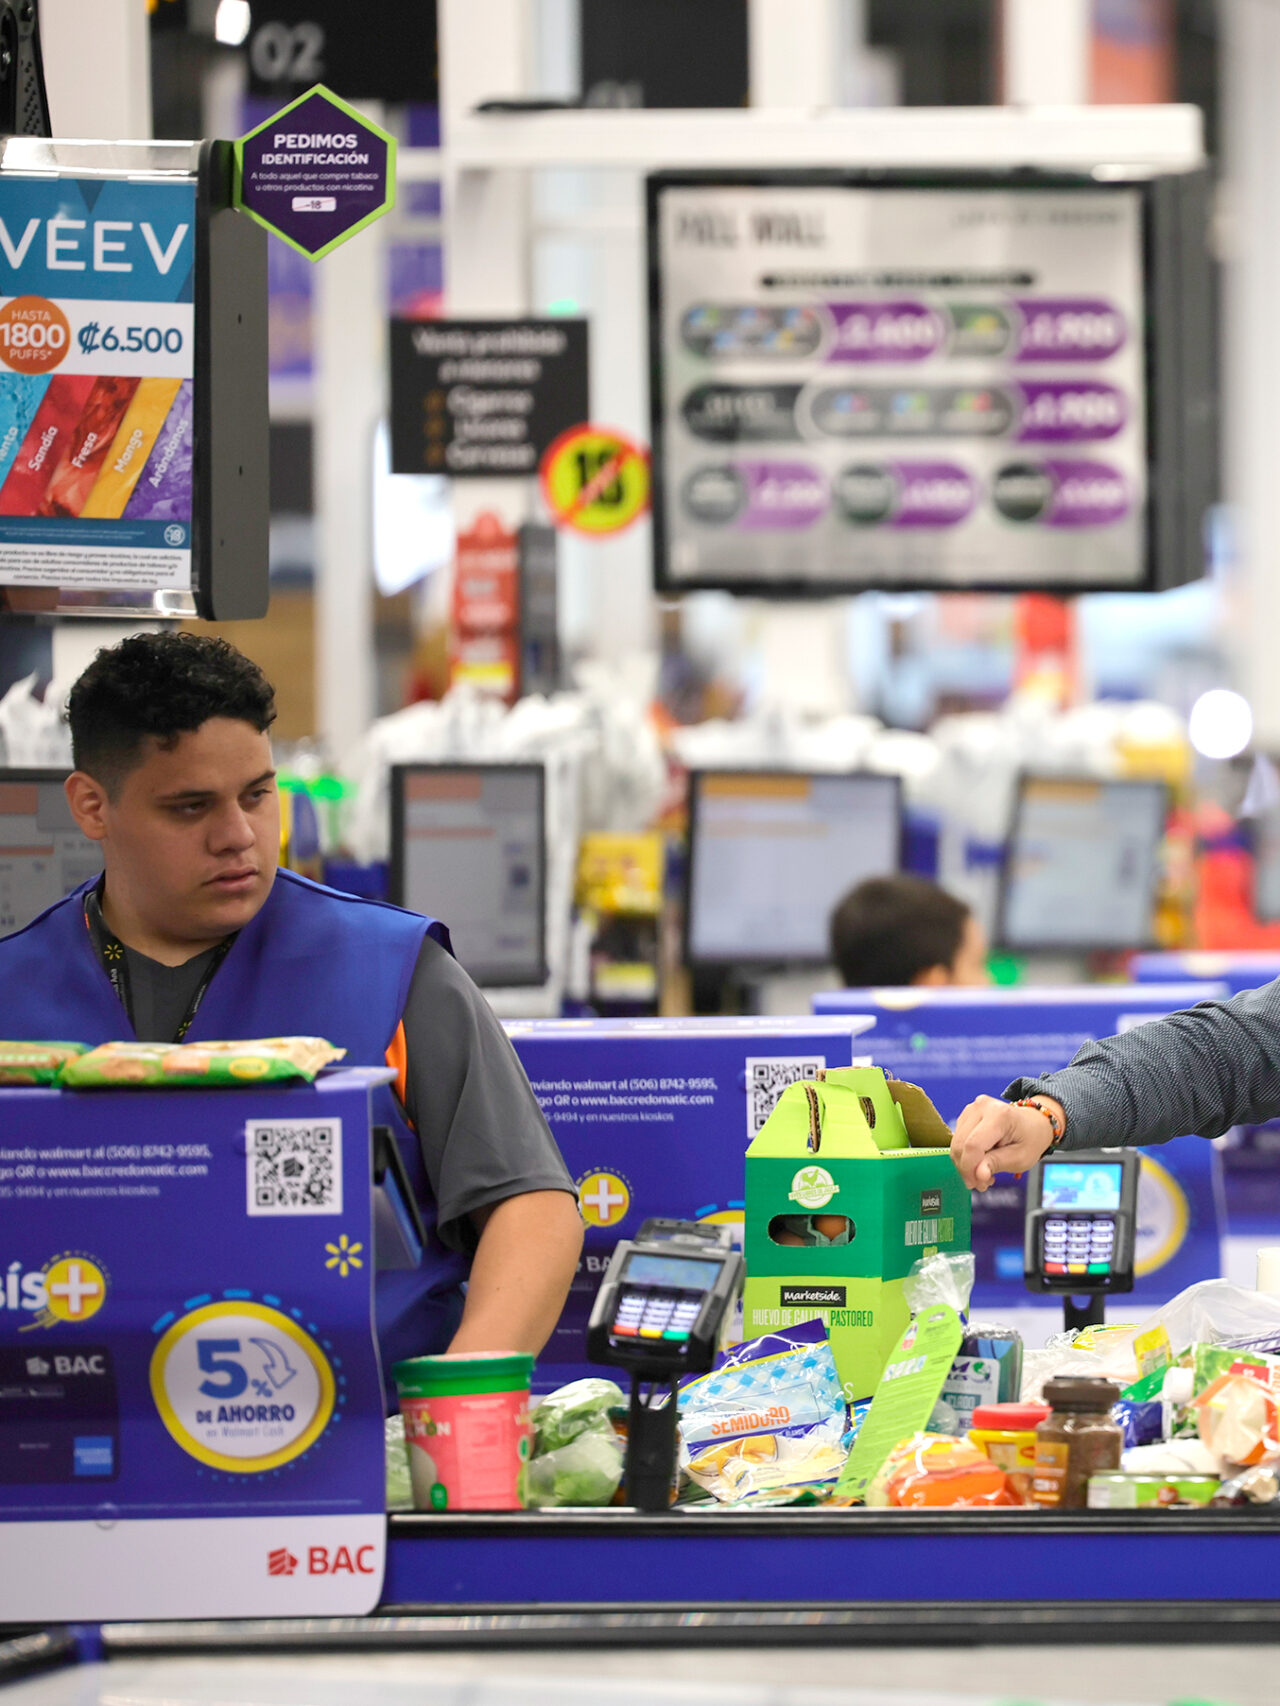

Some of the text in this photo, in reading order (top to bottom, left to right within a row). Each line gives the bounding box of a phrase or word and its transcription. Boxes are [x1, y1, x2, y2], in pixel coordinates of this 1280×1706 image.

[251, 20, 324, 79] 02
[274, 134, 358, 149] PEDIMOS
[262, 151, 369, 165] IDENTIFICACIÓN
[251, 172, 379, 182] A todo aquel que compre tabaco
[262, 184, 283, 192] otros
[283, 183, 325, 193] productos
[342, 183, 374, 192] nicotina
[0, 218, 190, 275] VEEV
[11, 310, 51, 322] HASTA
[0, 323, 66, 349] 1800
[0, 426, 19, 462] enta
[71, 431, 98, 469] Fresa
[113, 428, 144, 473] Mango
[530, 1077, 718, 1092] nviando walmart al (506) 8742-9595,
[554, 1095, 570, 1106] QR
[580, 1093, 714, 1106] www.baccredomatic.com
[599, 1112, 639, 1122] nuestros
[640, 1111, 674, 1122] kioskos
[0, 1146, 37, 1160] iando
[38, 1146, 91, 1160] walmart
[0, 1167, 15, 1180] go
[15, 1165, 36, 1178] QR
[586, 1256, 612, 1273] BA
[752, 1309, 780, 1327] HUEVO
[781, 1310, 792, 1327] DE
[830, 1310, 873, 1327] PASTOREO
[54, 1355, 105, 1375] BAC
[197, 1339, 273, 1399] 5%
[196, 1404, 295, 1423] DE AHORRO
[307, 1545, 375, 1575] BAC
